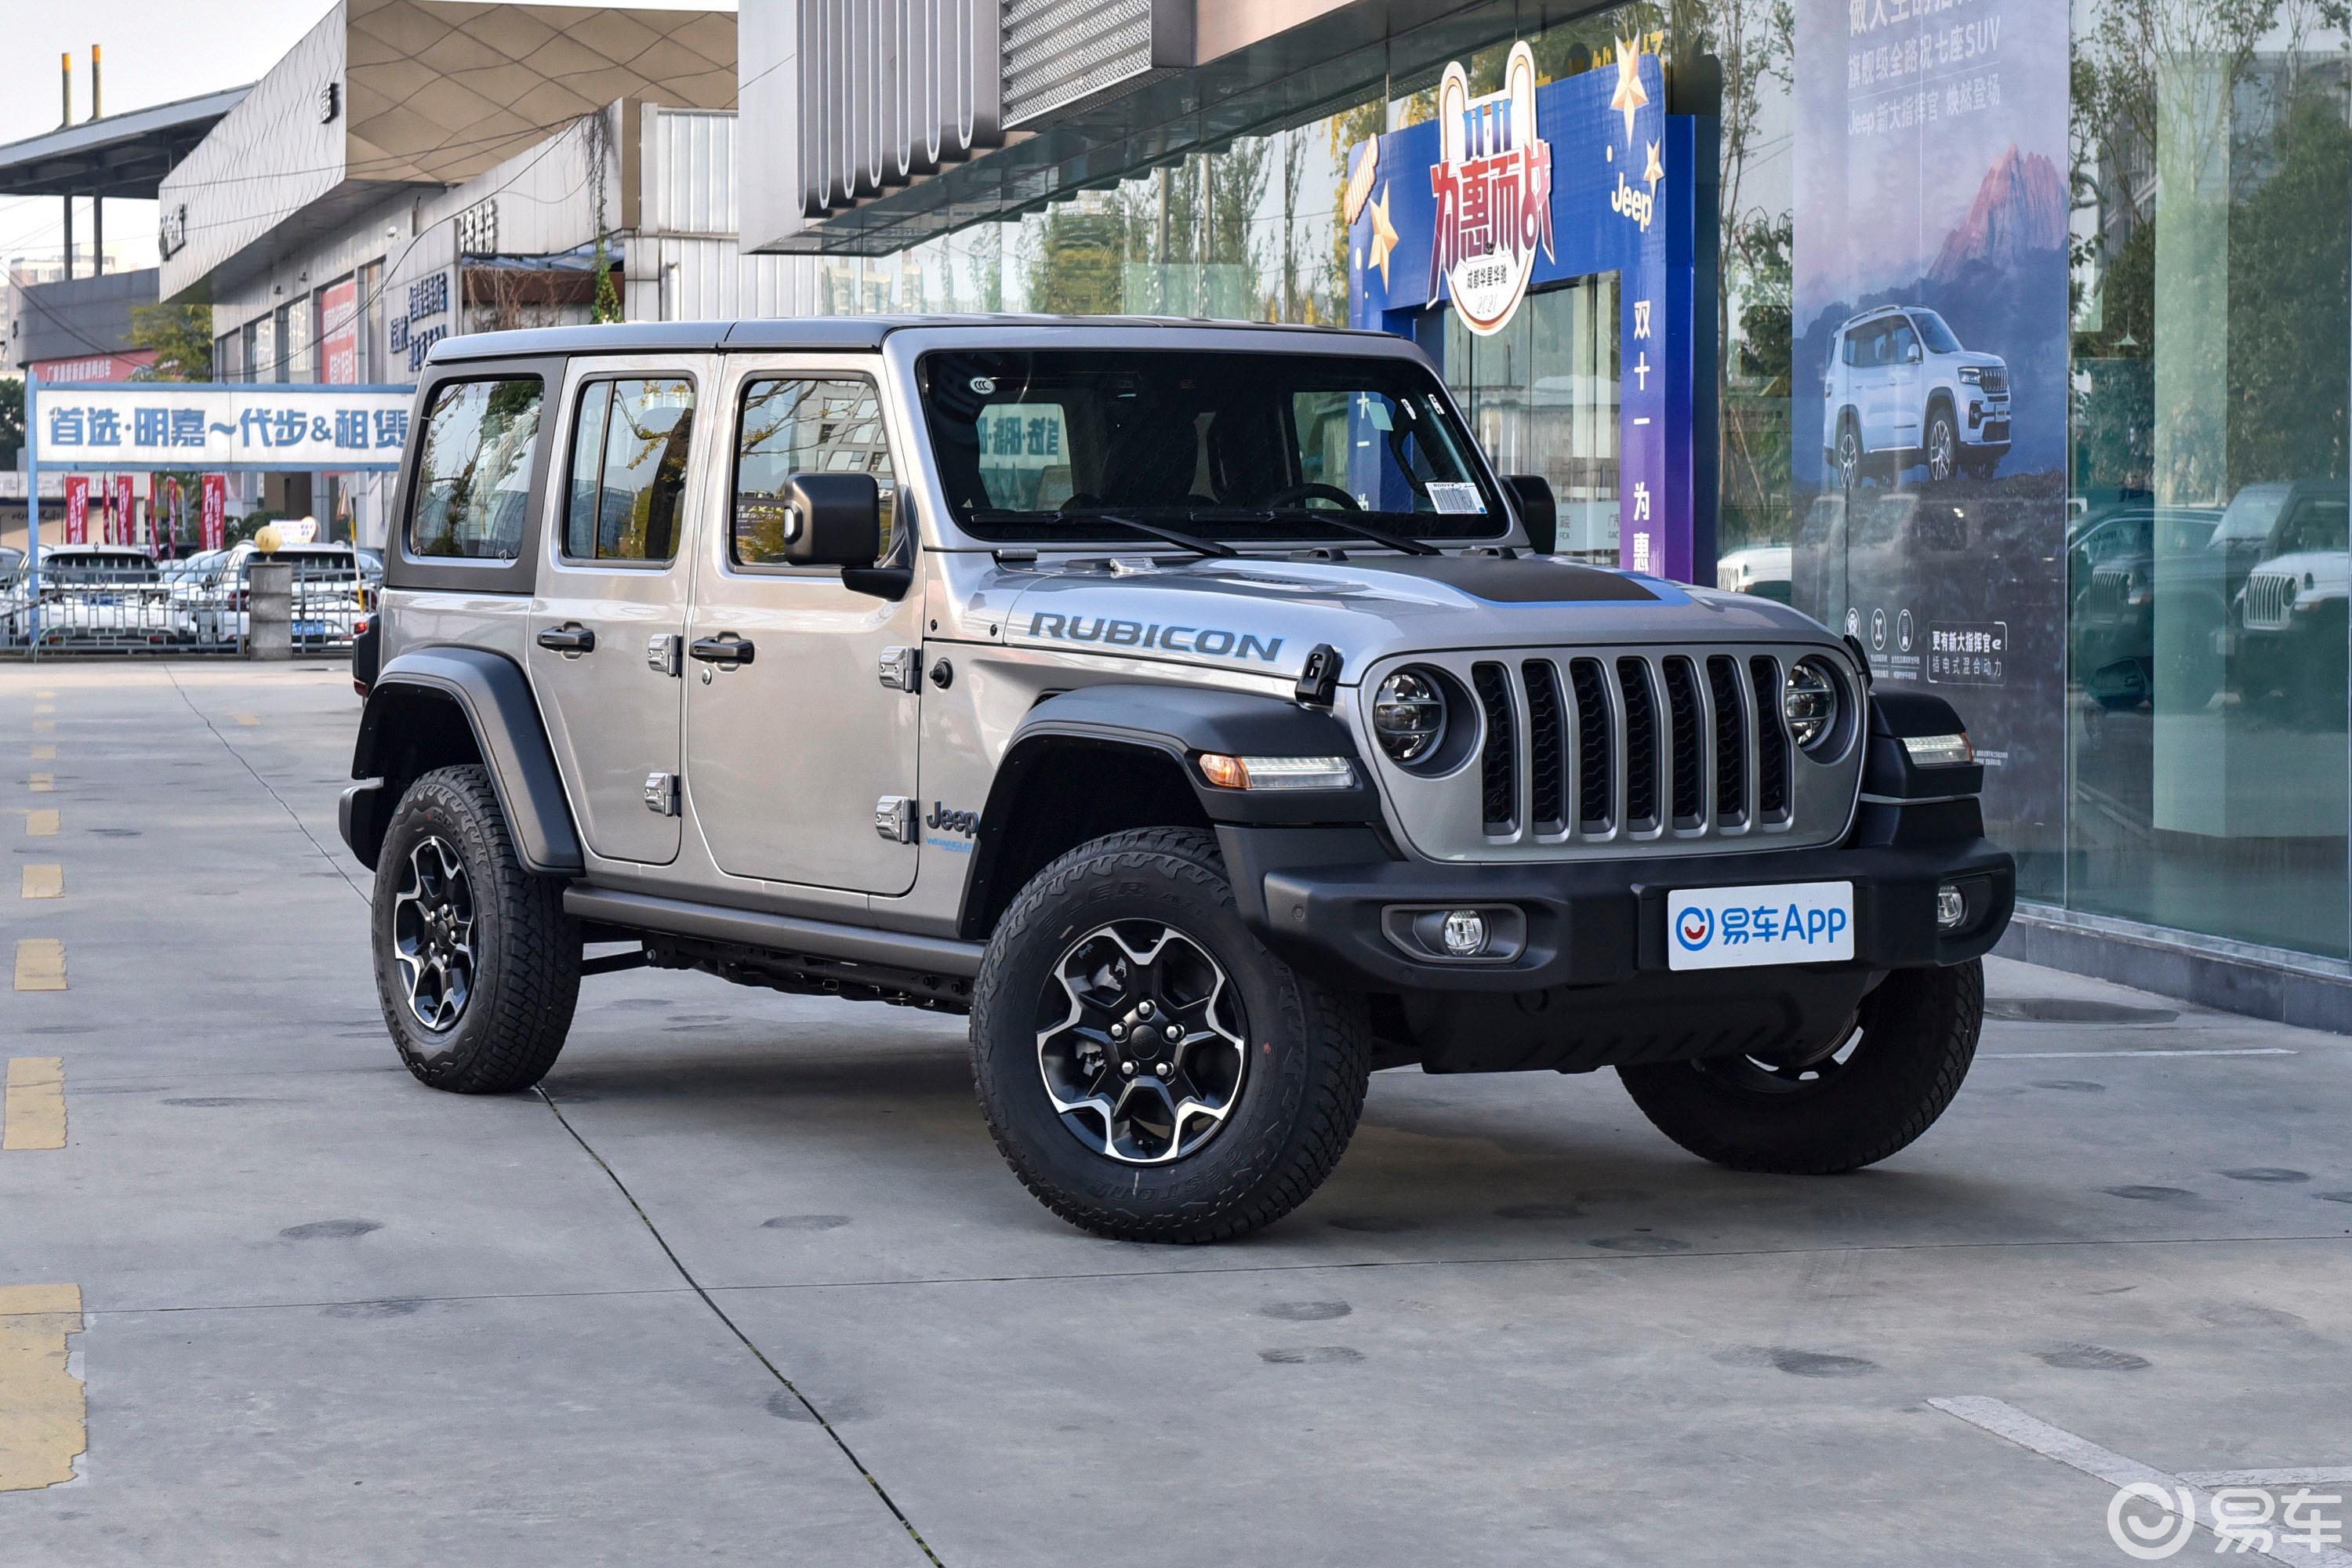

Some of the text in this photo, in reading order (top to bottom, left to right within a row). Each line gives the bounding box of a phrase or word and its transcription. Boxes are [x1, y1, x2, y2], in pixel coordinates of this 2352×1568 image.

[1848, 110, 1874, 136] Jeep
[1611, 172, 1653, 233] Jeep
[1633, 300, 1650, 425] 双十一
[1029, 612, 1284, 662] RUBICON
[1933, 655, 2002, 677] 插电式混合动力
[926, 800, 979, 839] Jeep
[1720, 902, 1847, 946] 易车App
